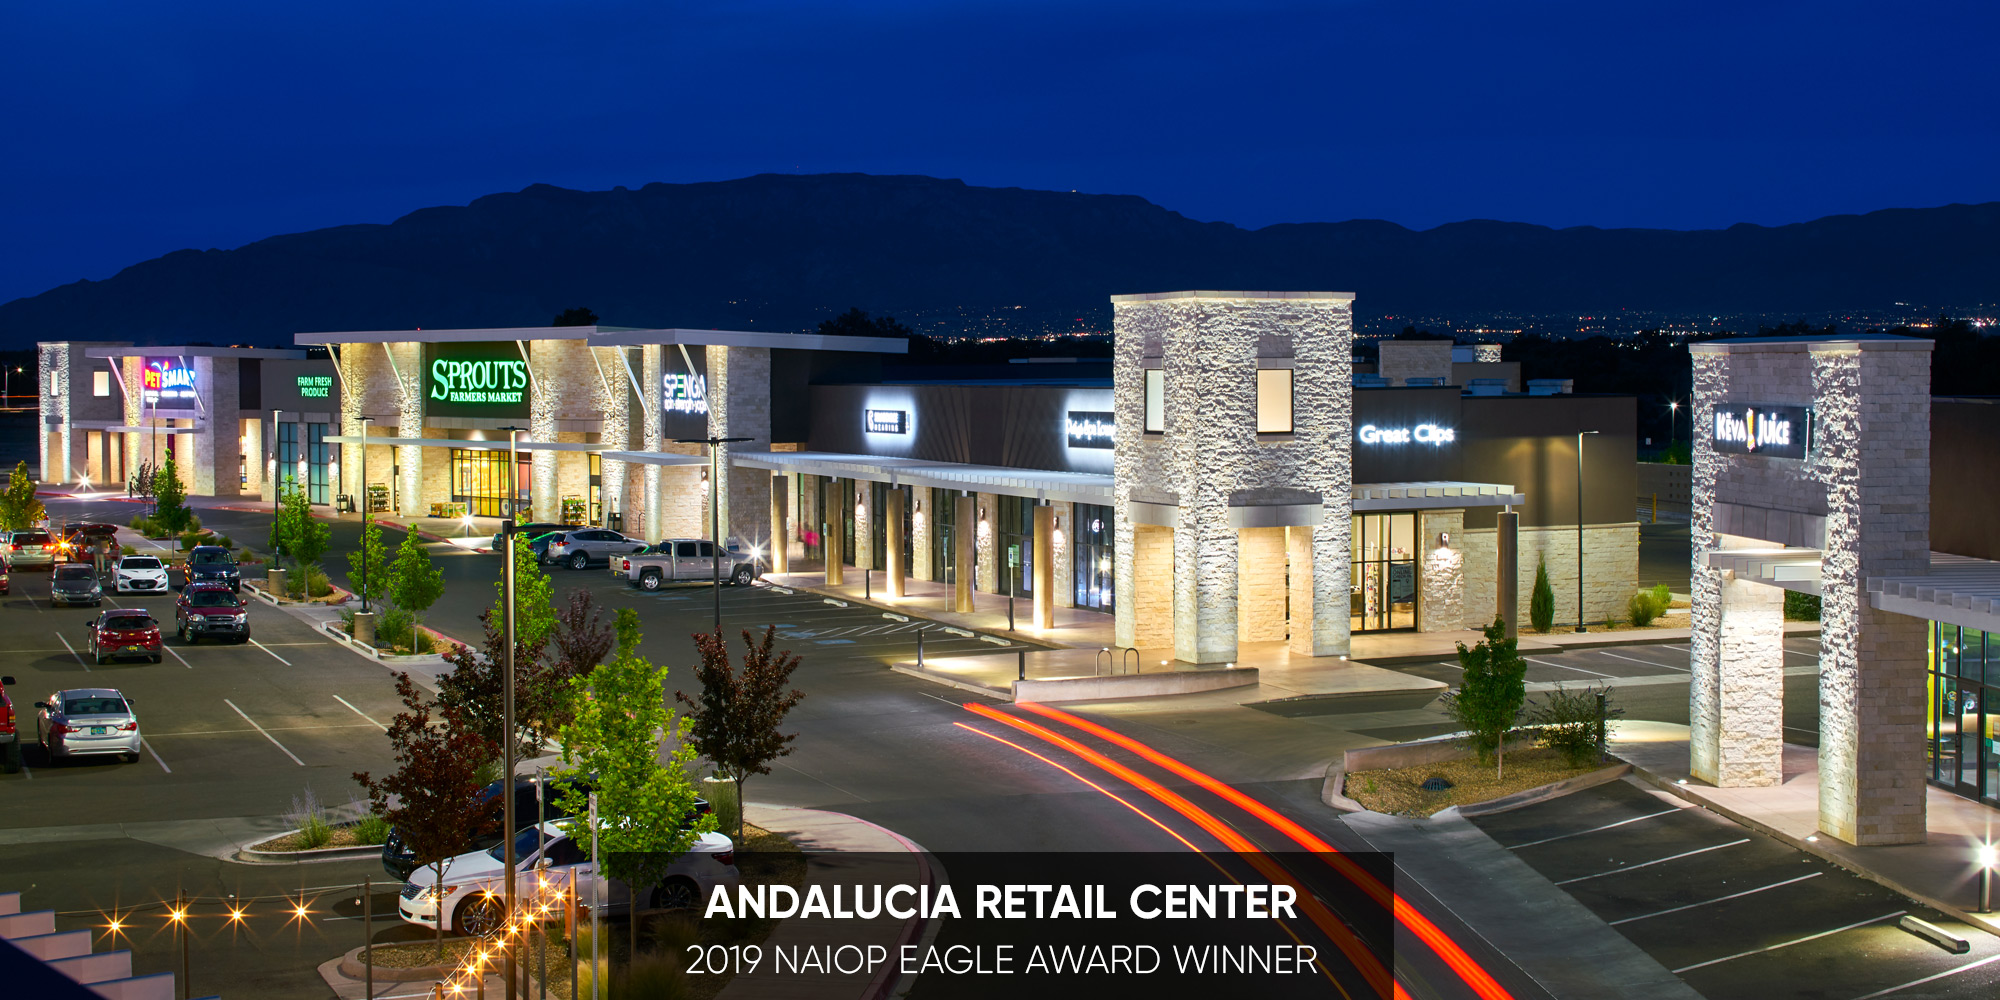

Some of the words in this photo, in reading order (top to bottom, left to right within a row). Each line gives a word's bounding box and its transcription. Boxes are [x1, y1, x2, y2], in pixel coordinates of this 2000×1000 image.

[297, 376, 313, 387] FARM
[315, 376, 332, 387] FRESH
[431, 359, 527, 400] SPROUTS
[301, 387, 329, 397] PRODUCE
[450, 391, 487, 402] FARMERS
[488, 391, 522, 402] MARKET
[1359, 424, 1411, 443] Great
[1413, 424, 1455, 447] Clips
